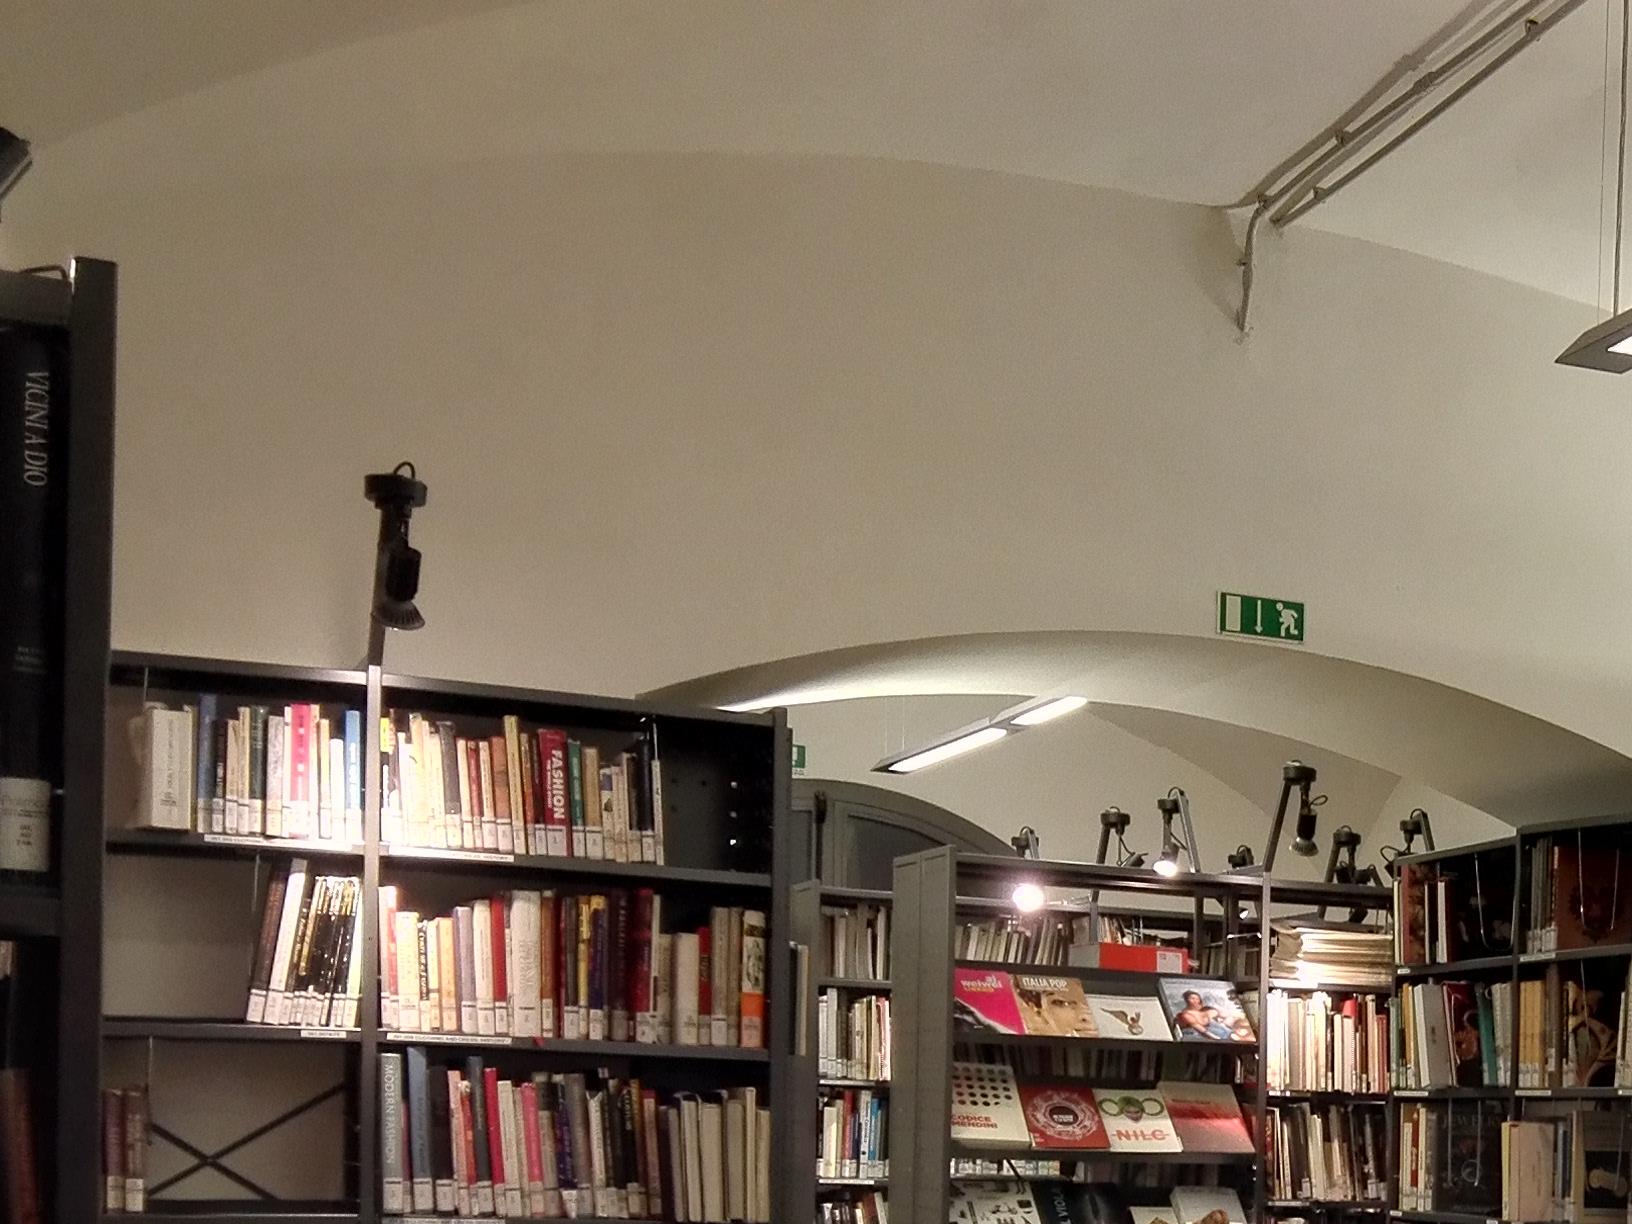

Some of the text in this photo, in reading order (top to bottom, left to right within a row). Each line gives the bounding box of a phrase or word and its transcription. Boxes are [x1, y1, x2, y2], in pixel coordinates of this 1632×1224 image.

[24, 371, 49, 486] VICINI A DIO
[551, 748, 565, 819] FASHION
[1049, 979, 1068, 988] POP
[384, 1064, 397, 1165] MODERN FASHION
